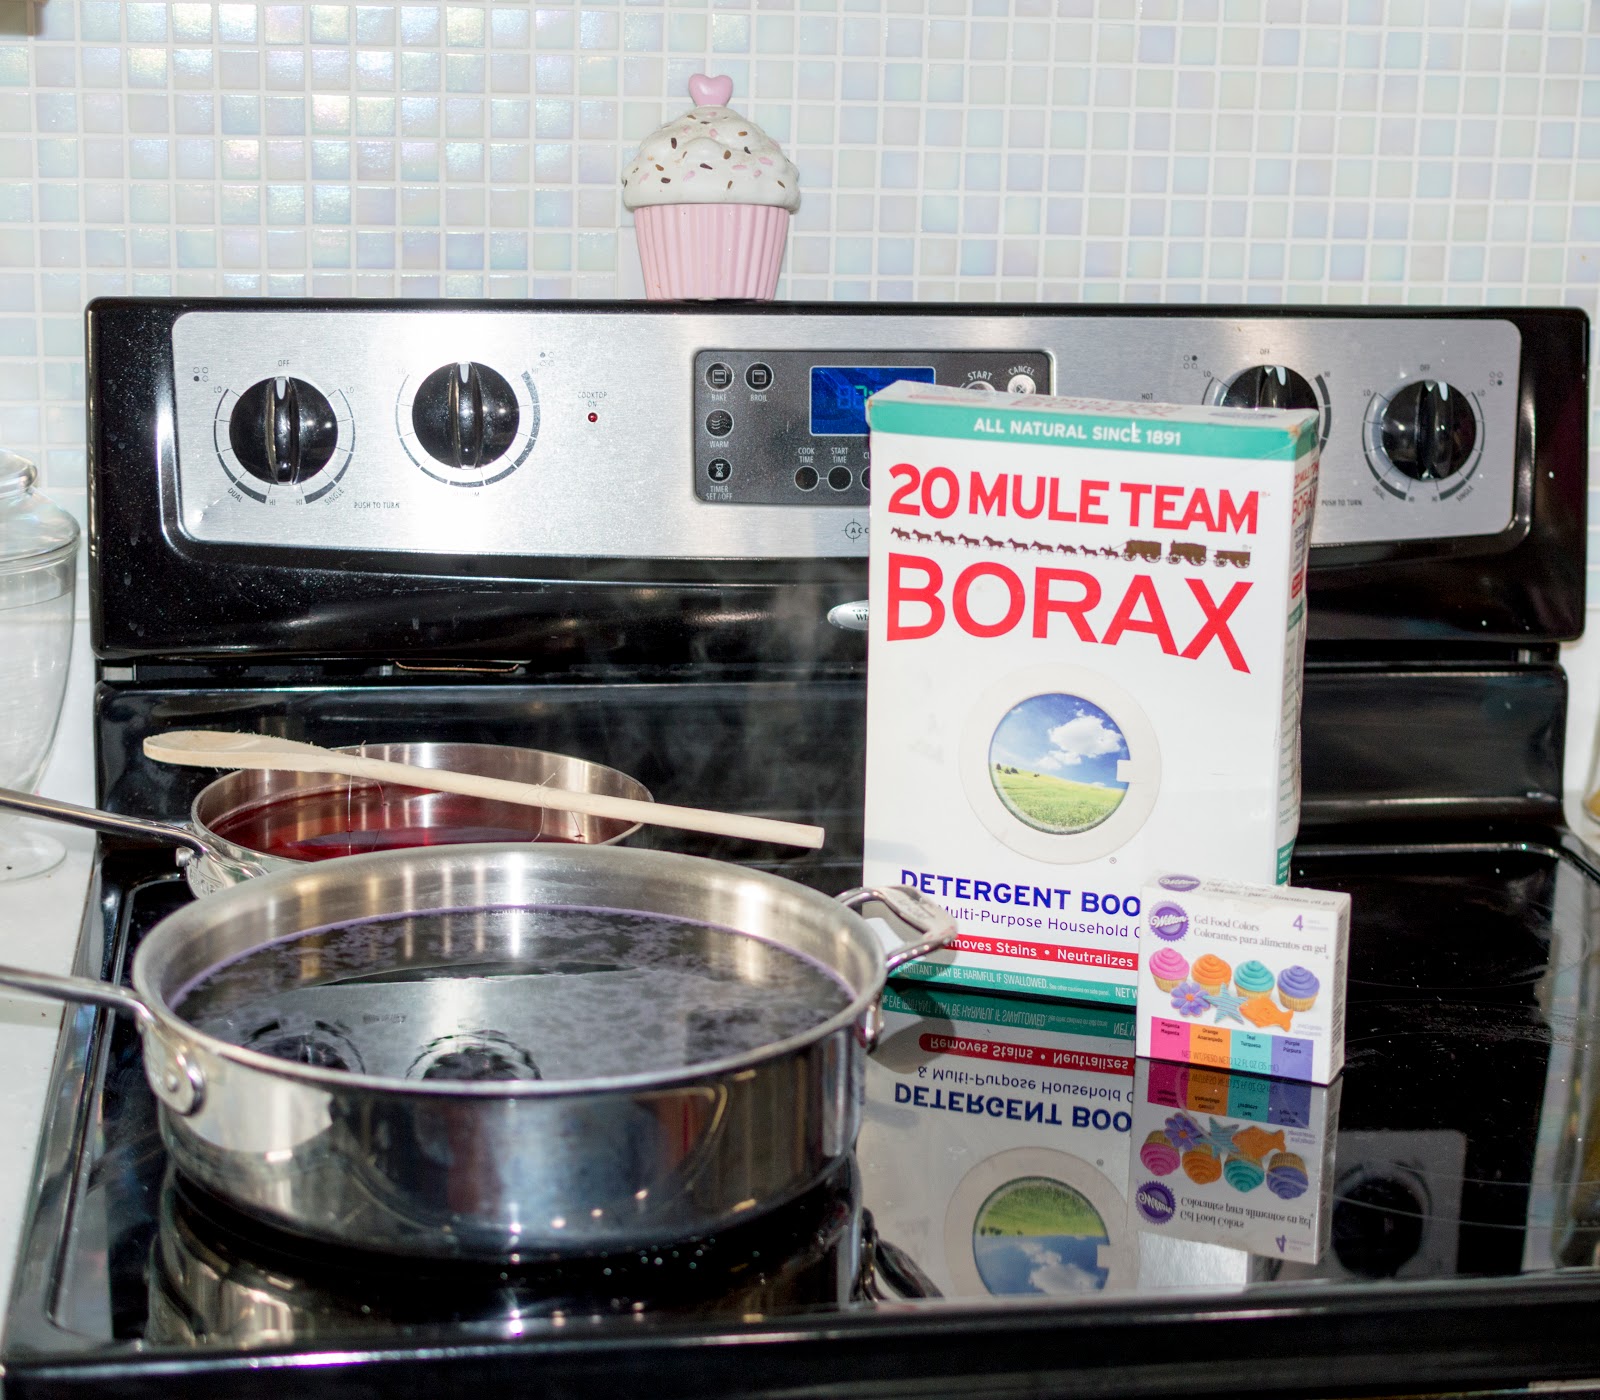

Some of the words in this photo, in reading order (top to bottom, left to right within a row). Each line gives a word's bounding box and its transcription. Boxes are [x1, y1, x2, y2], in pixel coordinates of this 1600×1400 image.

[1259, 348, 1271, 356] OFF
[277, 359, 290, 367] OFF
[1419, 364, 1431, 372] OFF
[967, 371, 993, 381] START
[1008, 365, 1035, 377] CANCEL
[213, 386, 223, 394] LO
[346, 386, 355, 394] LO
[577, 390, 608, 400] COOKTOP
[711, 394, 728, 402] BAKE
[750, 394, 768, 402] BROIL
[587, 400, 598, 408] ON
[973, 417, 1005, 434] ALL
[1010, 420, 1088, 440] NATURAL
[1092, 427, 1141, 444] SINCE
[1146, 429, 1182, 446] 1891
[709, 440, 729, 448] WARM
[797, 447, 815, 456] COOK
[830, 447, 849, 455] START
[799, 455, 814, 464] TIME
[832, 455, 847, 464] TIME
[709, 485, 729, 493] TIMER
[227, 487, 243, 504] DUAL
[324, 488, 345, 506] SINGLE
[888, 463, 961, 520] 20
[969, 471, 1110, 525] MULE
[1120, 482, 1259, 534] TEAM
[887, 552, 1254, 675] BORAX
[901, 869, 1071, 910] DETERGENT
[1081, 891, 1141, 917] BOO
[944, 905, 1043, 929] ulti-Purpose
[1048, 918, 1128, 938] Household
[1150, 914, 1189, 930] Wilton
[1194, 914, 1209, 925] Gel
[1210, 917, 1231, 928] Food
[1232, 920, 1260, 932] Colors
[1292, 914, 1304, 931] 4
[1193, 928, 1238, 943] Colorantes
[1239, 935, 1259, 945] para
[1259, 937, 1301, 951] alimentos
[1302, 944, 1313, 952] en
[1314, 945, 1327, 954] gel
[949, 939, 992, 952] moves
[996, 942, 1037, 957] Stains
[1057, 949, 1134, 968] Neutralizes
[936, 966, 952, 978] MAY
[953, 968, 962, 979] BE
[963, 969, 995, 984] HARMFUL
[996, 972, 1002, 984] IF
[1003, 973, 1049, 990] SWALLOWED.
[1115, 986, 1130, 999] NET
